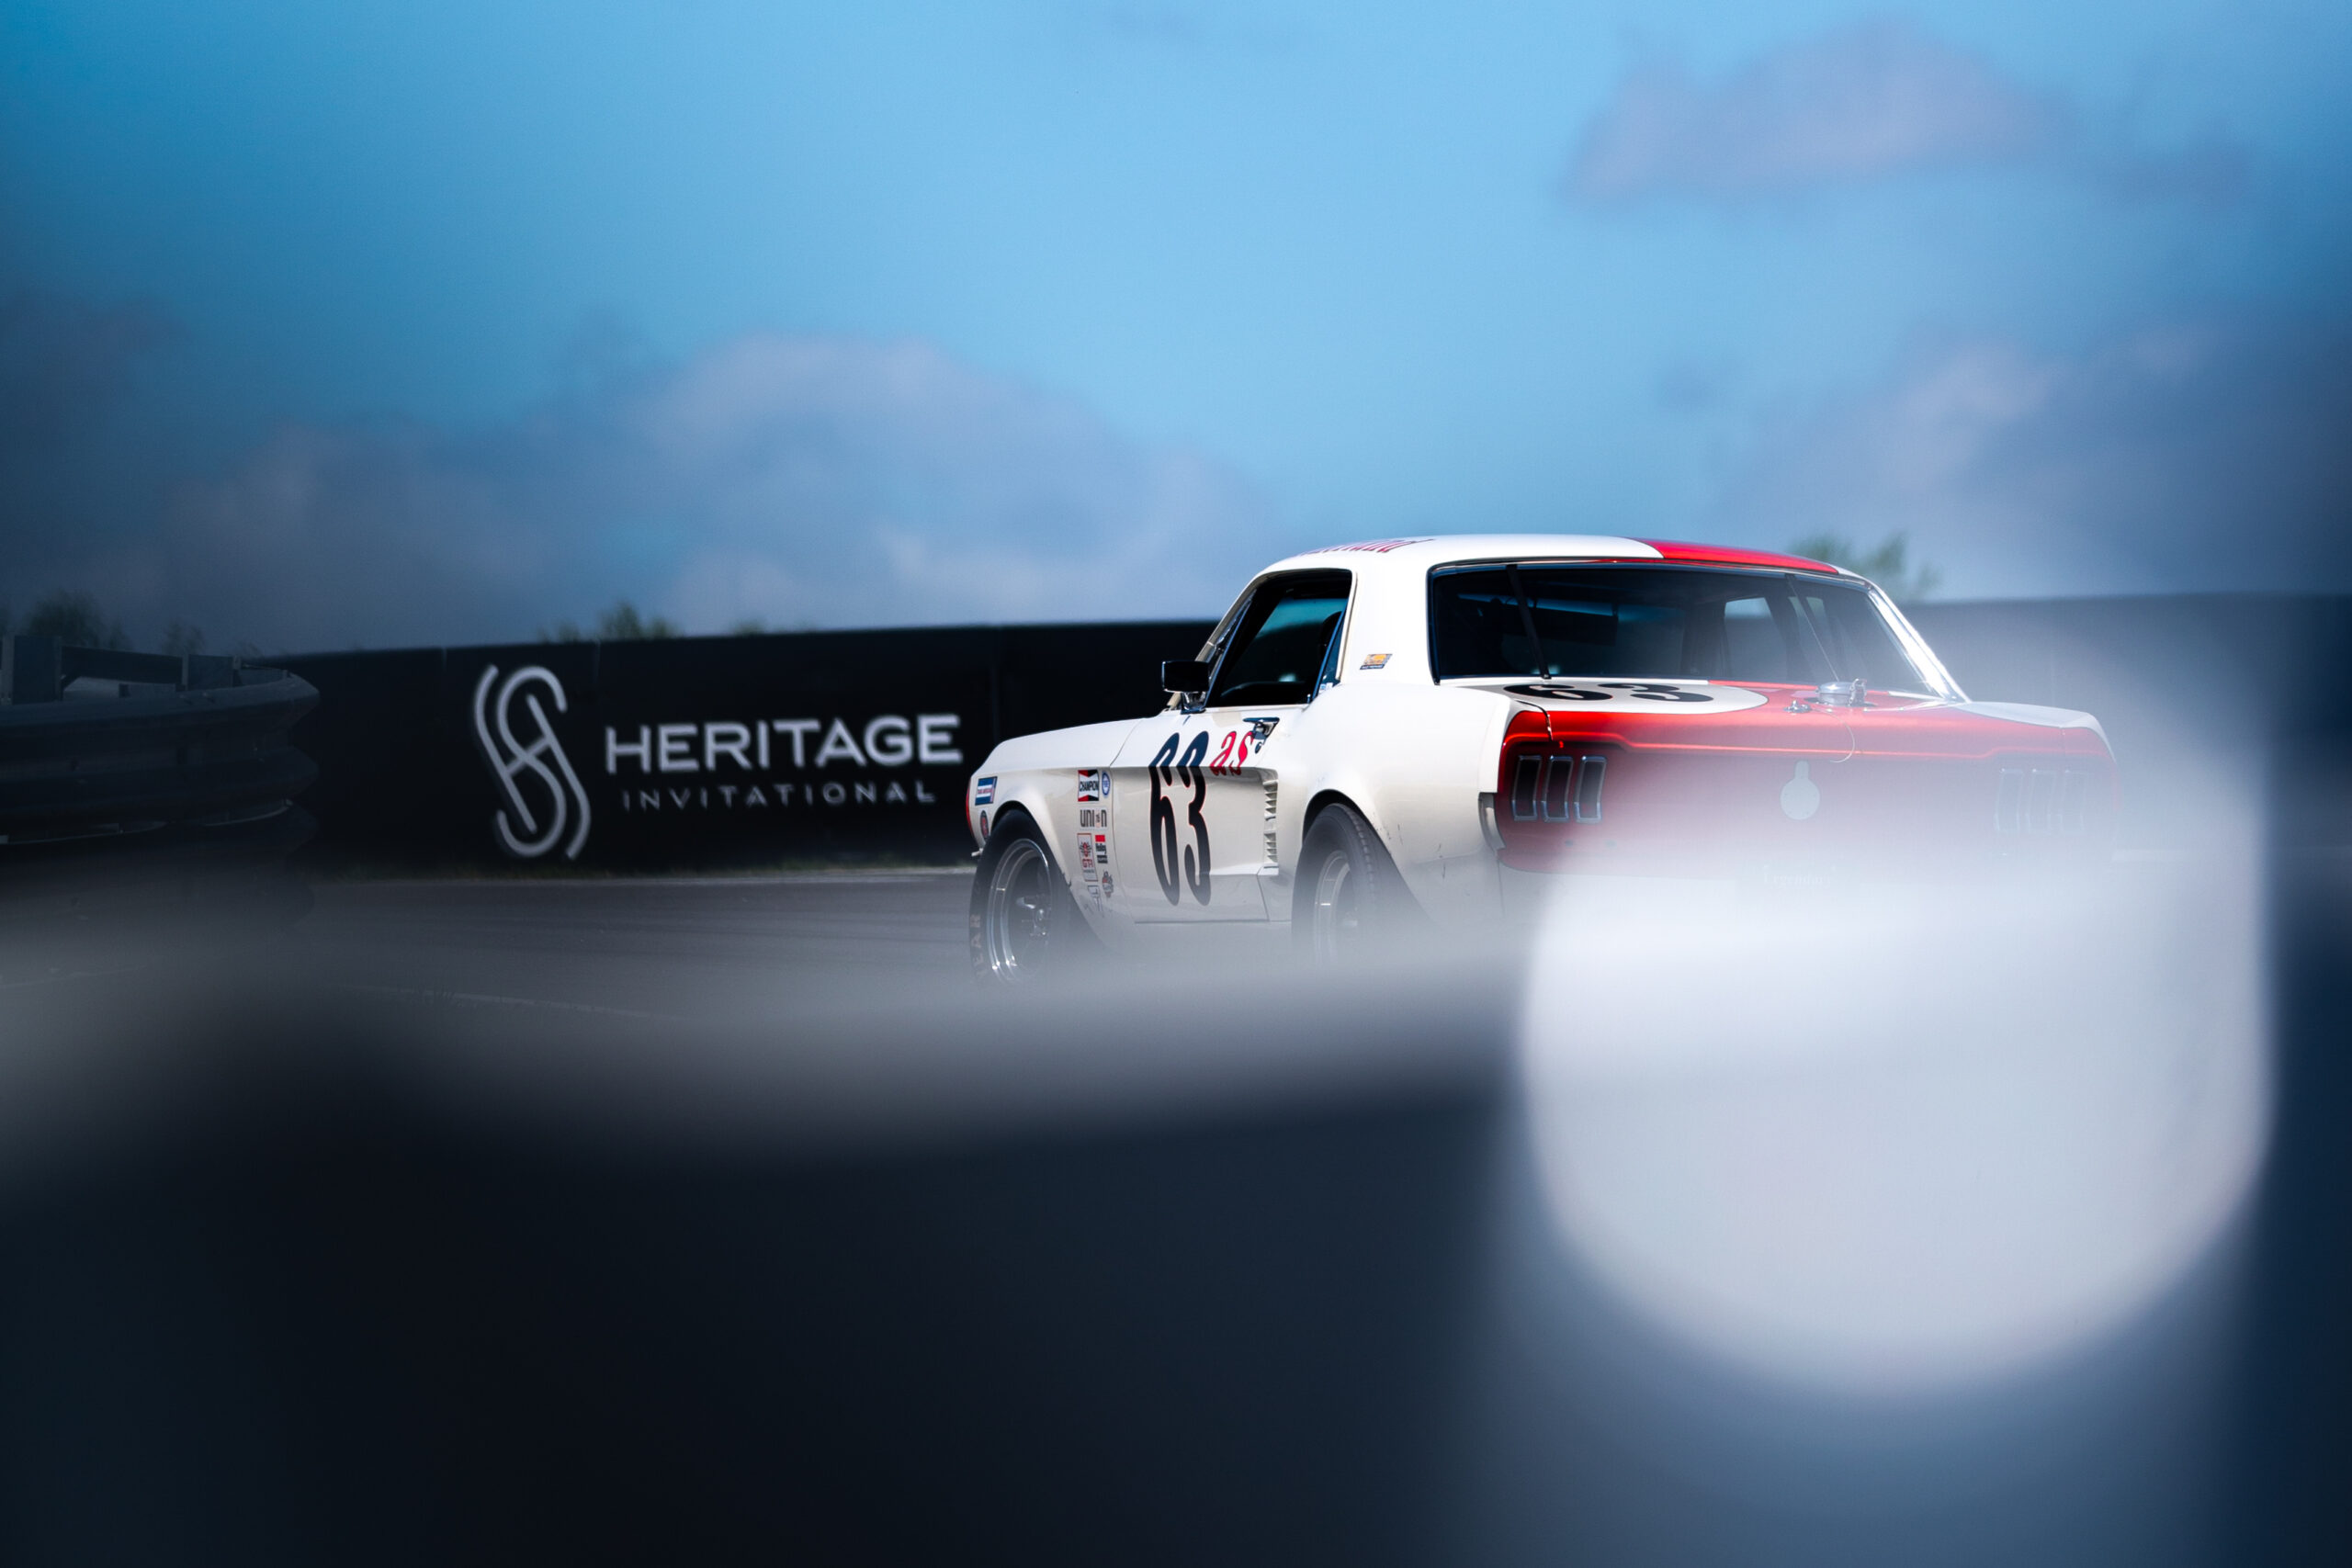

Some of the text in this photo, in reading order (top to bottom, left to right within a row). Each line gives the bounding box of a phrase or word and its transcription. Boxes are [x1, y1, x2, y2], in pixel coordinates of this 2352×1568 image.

[1503, 682, 1714, 703] 63
[605, 713, 963, 774] HERITAGE
[622, 780, 935, 811] INVITATIONAL
[1148, 731, 1211, 907] 63
